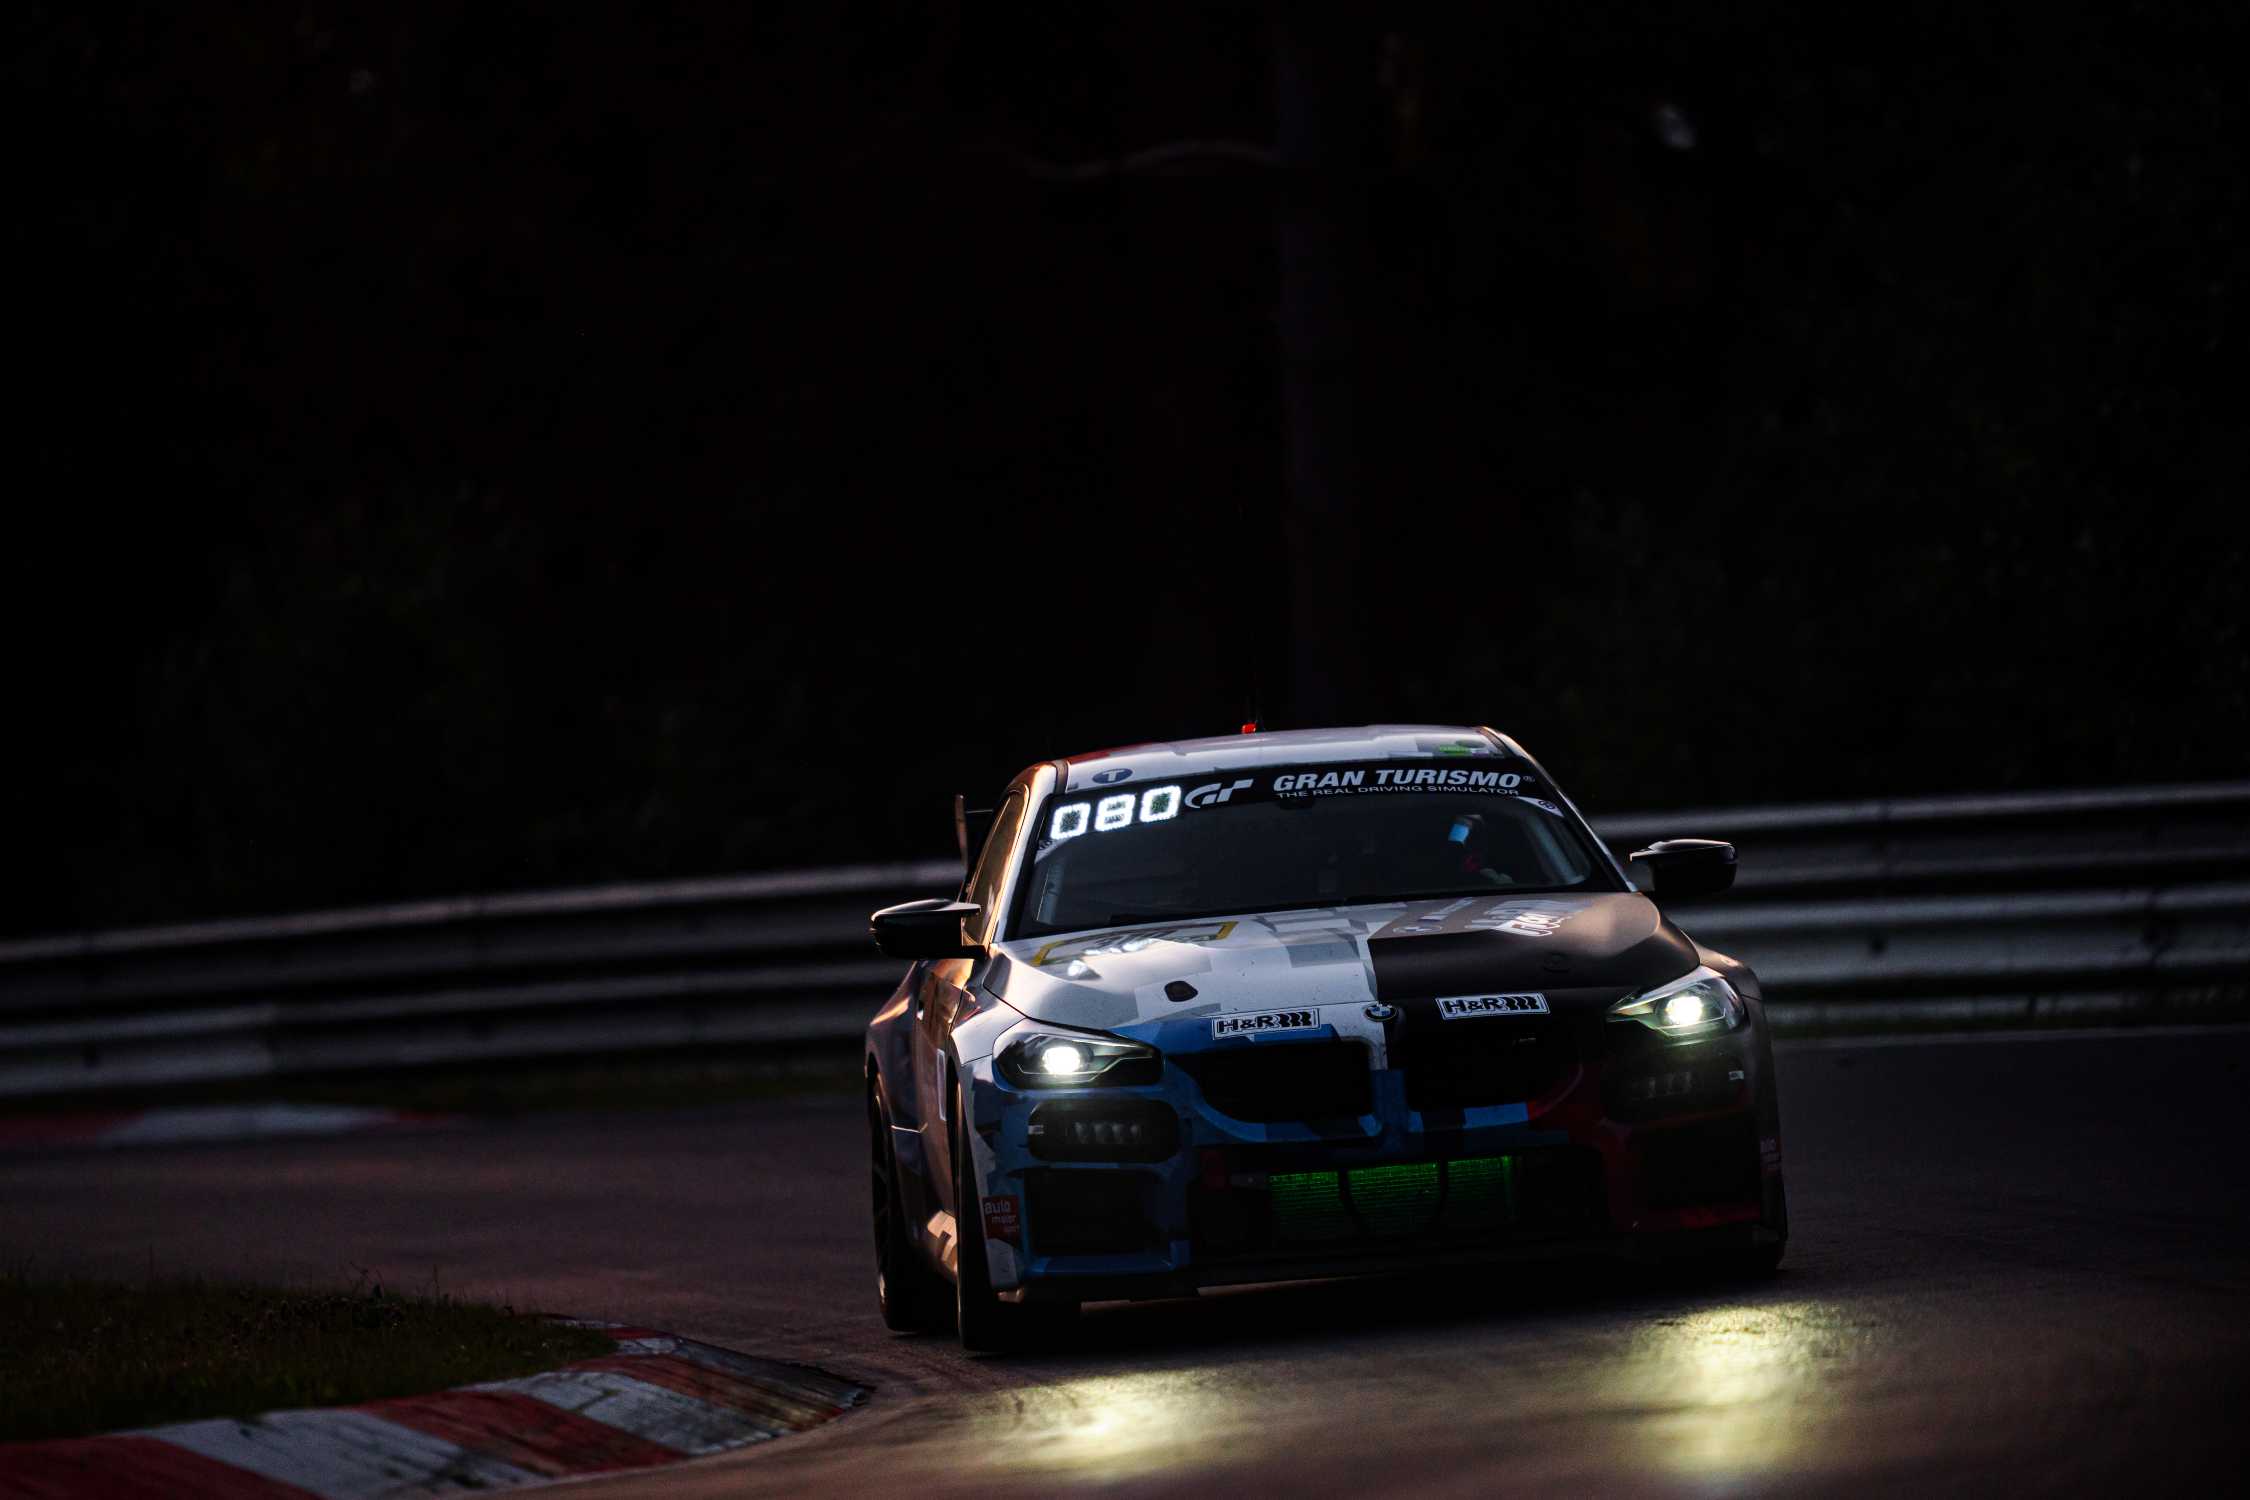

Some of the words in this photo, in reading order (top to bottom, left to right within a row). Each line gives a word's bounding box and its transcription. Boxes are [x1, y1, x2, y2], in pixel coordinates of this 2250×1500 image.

[1273, 770, 1365, 792] GRAN
[1376, 769, 1521, 788] TURISMO
[1278, 791, 1309, 799] THE
[1313, 787, 1354, 796] REAL
[1358, 785, 1420, 793] DRIVING
[1427, 785, 1519, 795] SIMULATOR
[1050, 785, 1182, 840] 080
[1442, 996, 1502, 1014] H&R
[1218, 1015, 1274, 1033] H&R
